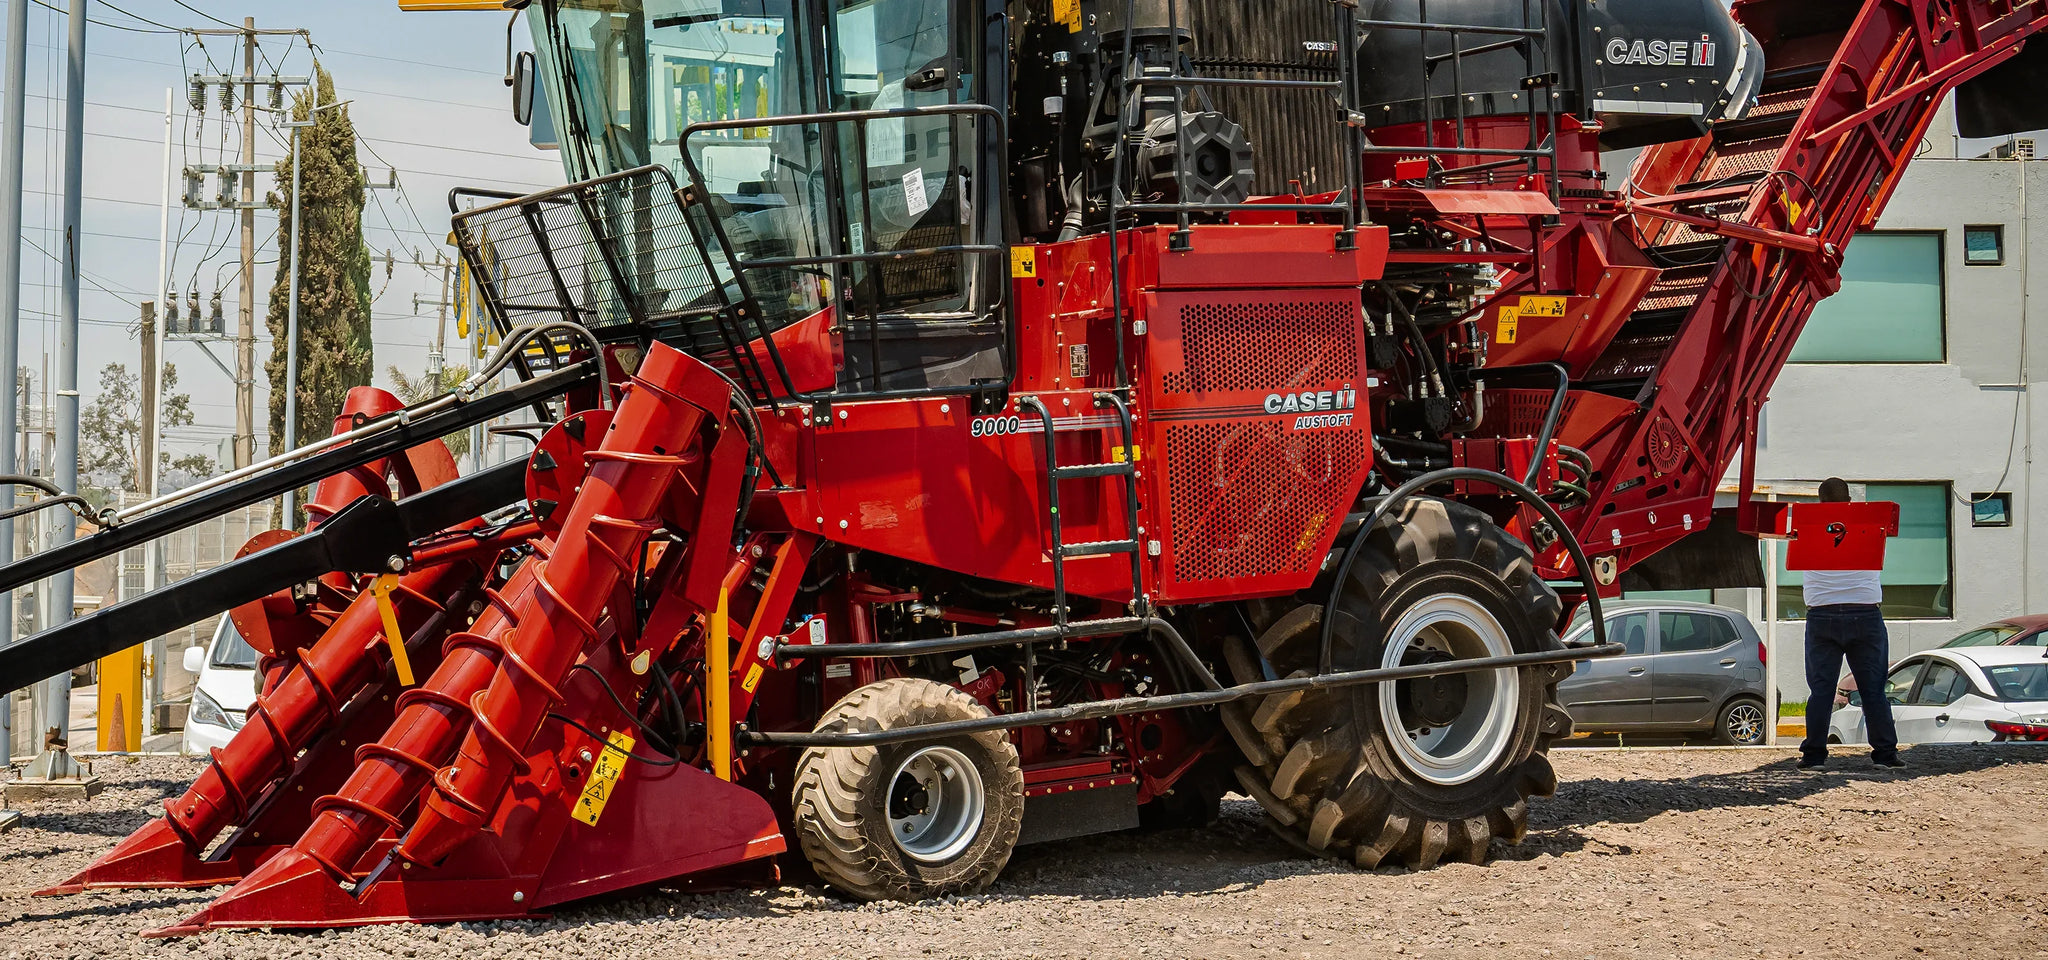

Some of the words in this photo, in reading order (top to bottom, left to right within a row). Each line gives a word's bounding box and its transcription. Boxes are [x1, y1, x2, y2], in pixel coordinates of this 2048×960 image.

[1306, 41, 1330, 51] CASE
[1606, 38, 1688, 66] CASE
[1264, 390, 1333, 414] CASE
[971, 415, 1020, 437] 9000
[1294, 413, 1353, 430] AUSTOFT
[976, 678, 991, 690] OK
